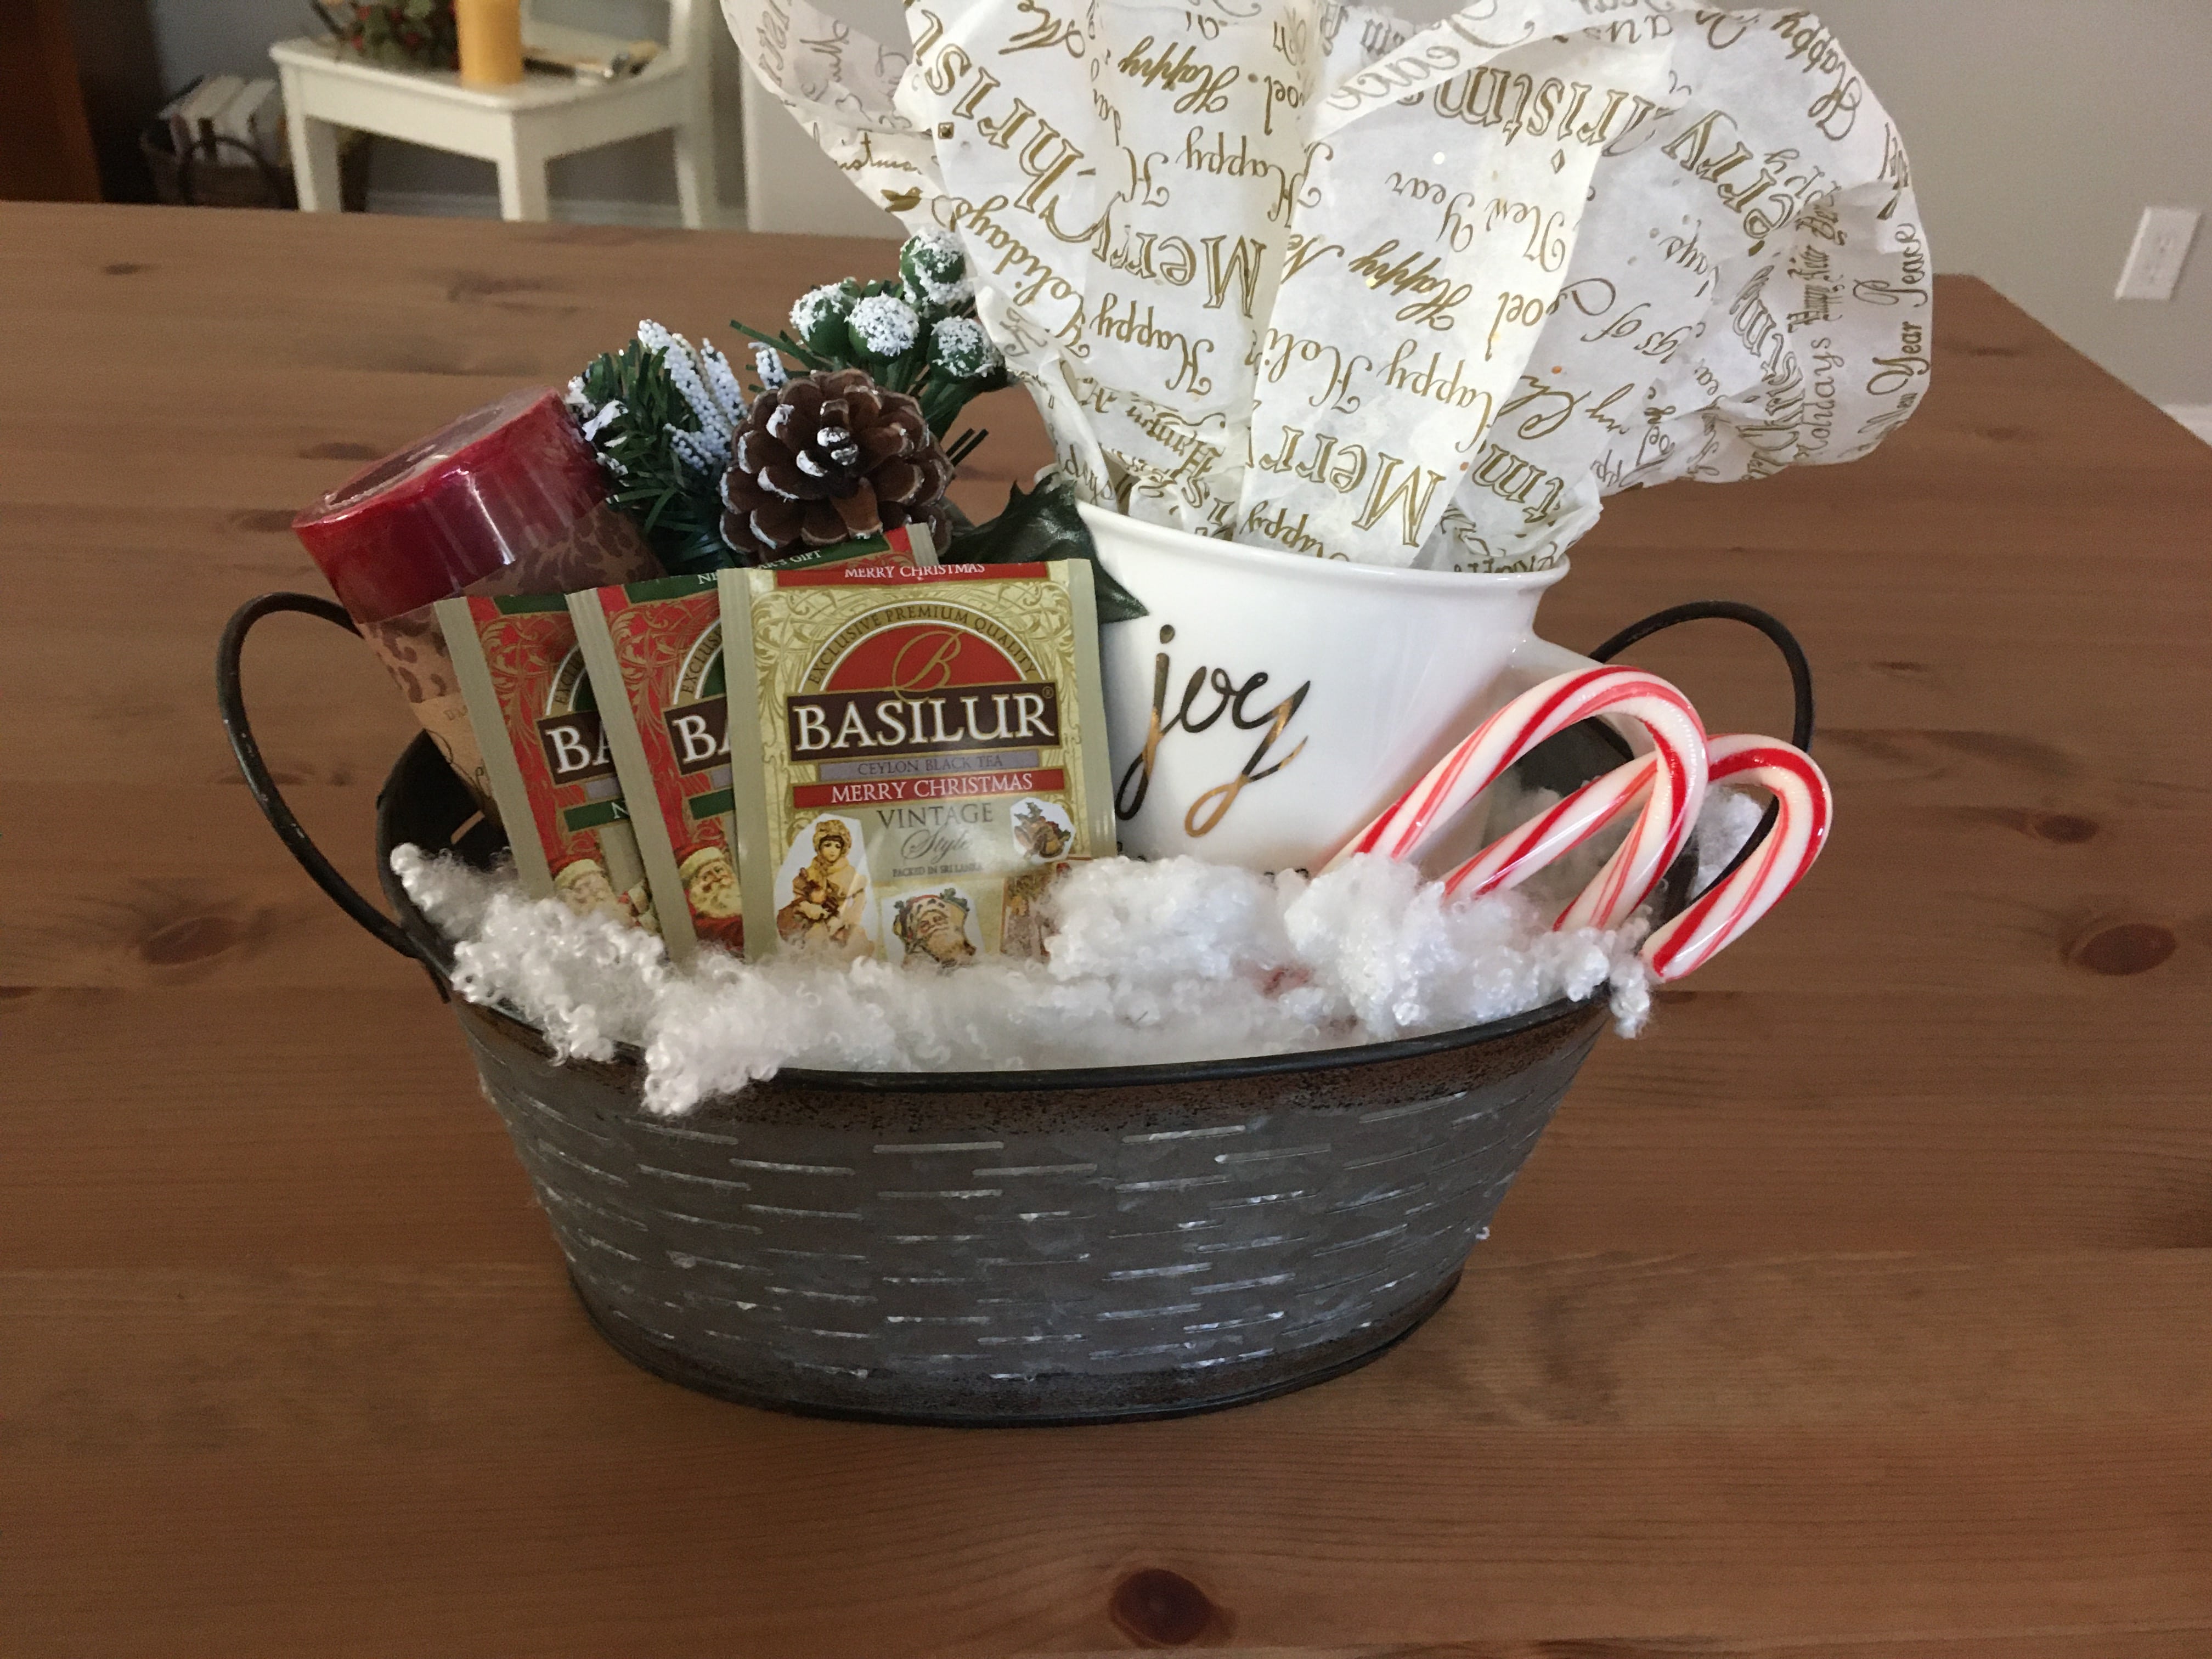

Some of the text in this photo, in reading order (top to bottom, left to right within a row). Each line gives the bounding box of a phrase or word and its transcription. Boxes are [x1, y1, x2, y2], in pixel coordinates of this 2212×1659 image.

[1118, 35, 1240, 114] Happy
[1384, 172, 1567, 273] New Year
[1348, 239, 1473, 332] Happy
[1852, 223, 1928, 308] Peace
[1089, 293, 1215, 396] Happy
[1866, 320, 1931, 396] Year
[844, 563, 986, 579] MERRY CHRISTMAS
[808, 604, 1037, 685] EXCLUSIVE PREMIUM QUALITY
[792, 692, 1056, 753] BASILUR
[1114, 624, 1311, 838] joy
[831, 772, 1034, 804] MERRY CHRISTMAS
[857, 754, 1003, 776] CEYLON BLACK TEA
[876, 803, 994, 830] VINTAGE
[901, 824, 972, 865] Style
